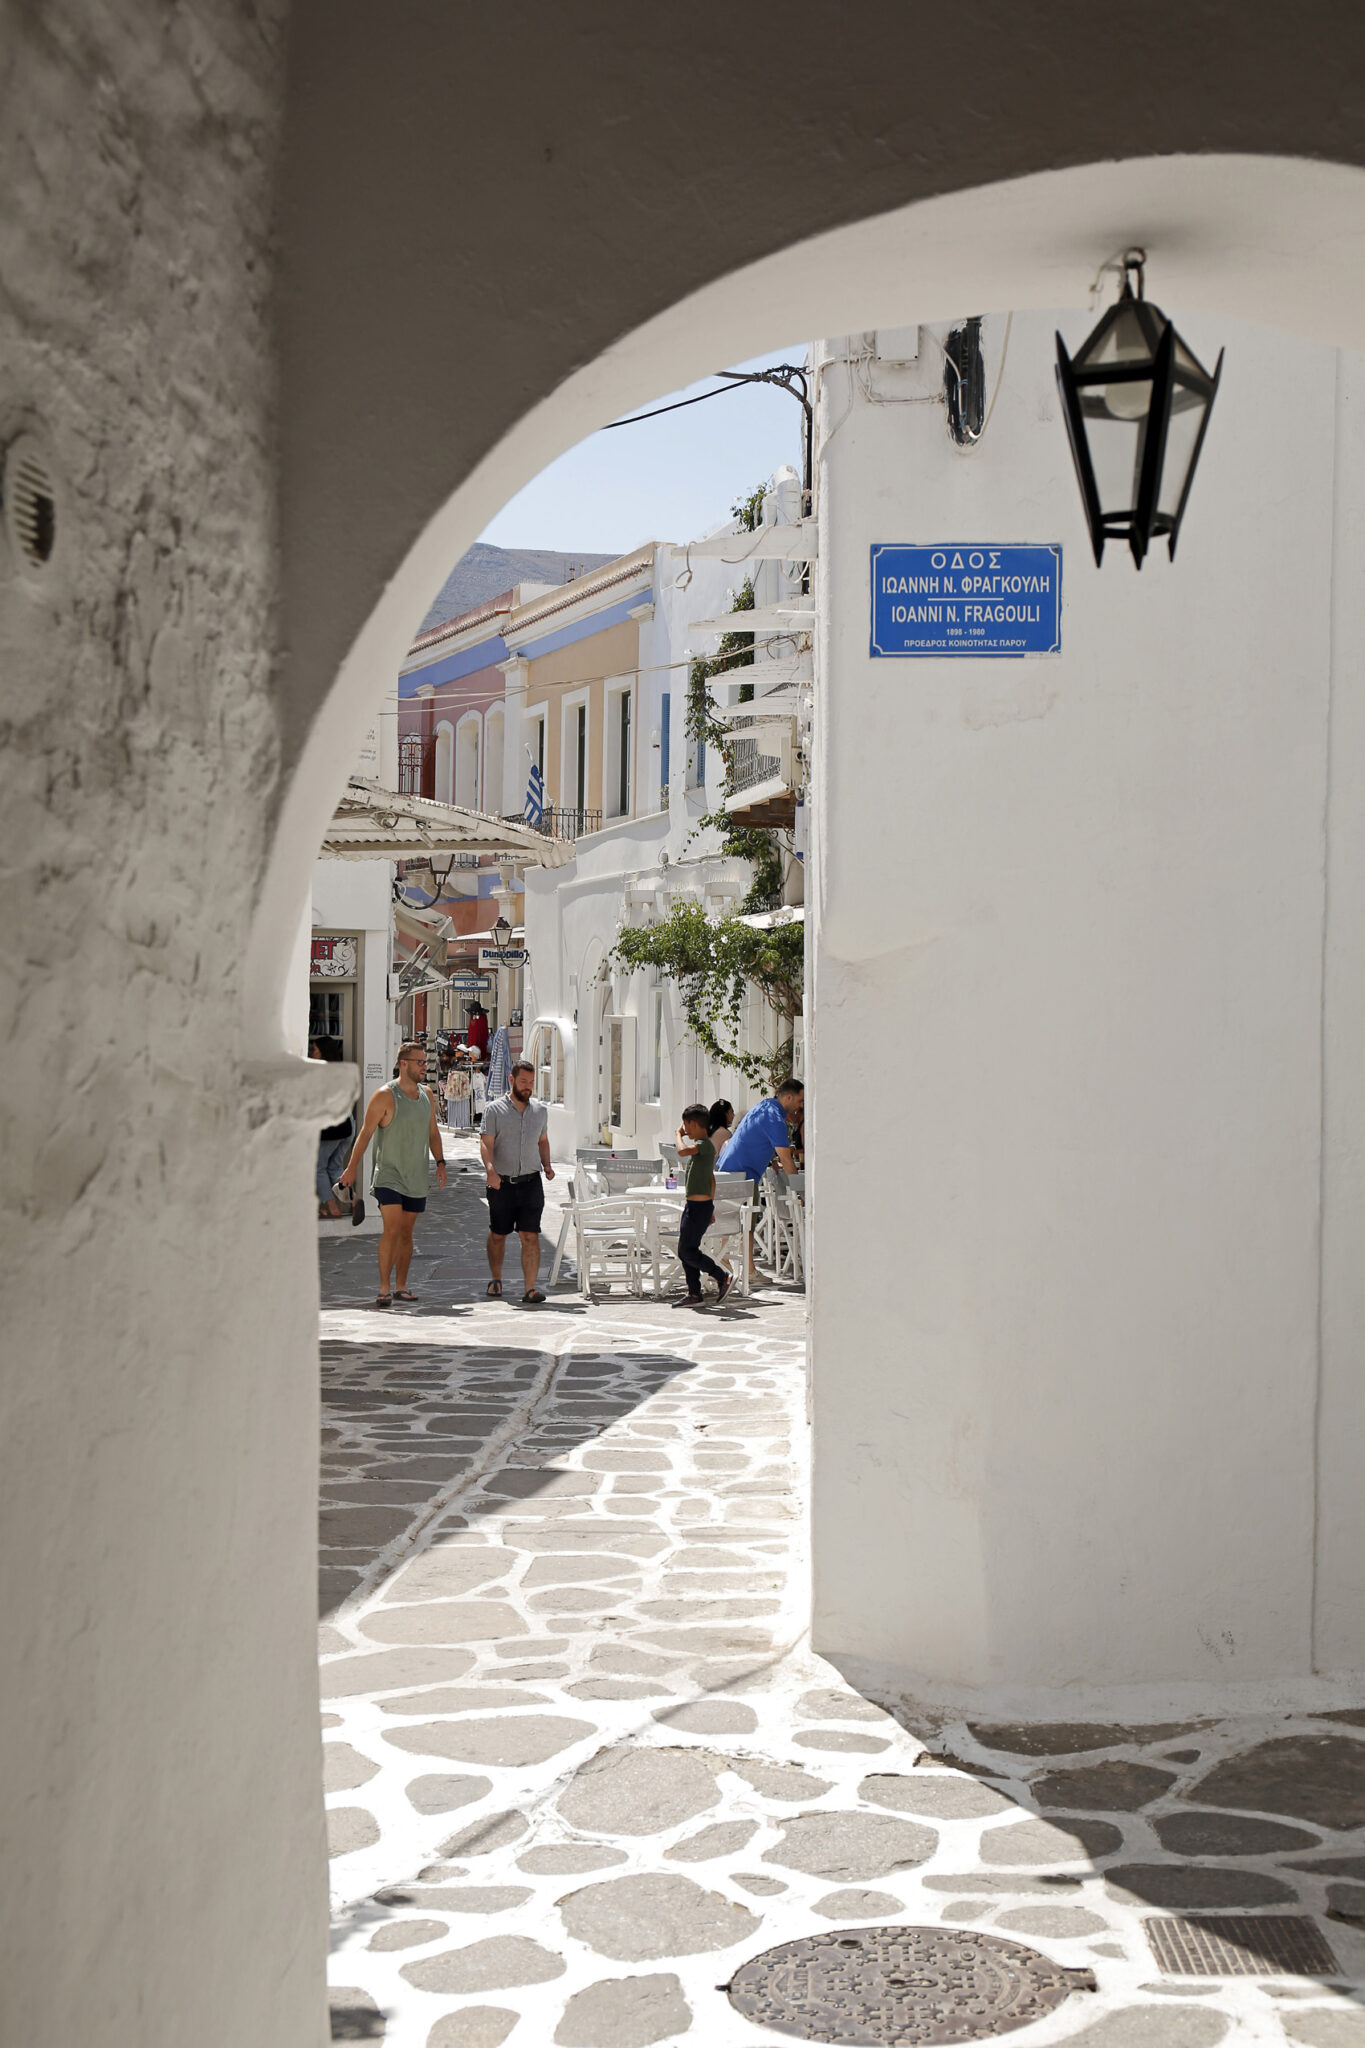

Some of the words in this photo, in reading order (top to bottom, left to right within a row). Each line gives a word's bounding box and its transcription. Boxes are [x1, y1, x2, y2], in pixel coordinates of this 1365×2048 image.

[931, 552, 1001, 569] ΟΔΟΣ
[882, 576, 939, 594] ΙΩΑΝΝΗ
[943, 576, 957, 593] Ν.
[961, 576, 1050, 594] ΦΡΑΓΚΟΥΛΗ
[891, 605, 942, 623] IOANNI
[946, 605, 960, 622] N.
[964, 605, 1040, 623] FRAGOULI
[969, 628, 986, 636] 1980
[904, 639, 947, 648] ΠΡΟΕΔΡΟΣ
[948, 639, 998, 647] ΚΟΙΝΟΤΗΤΑΣ
[999, 639, 1027, 647] ΠΑΡΟΥ
[482, 949, 524, 959] Dunopillo
